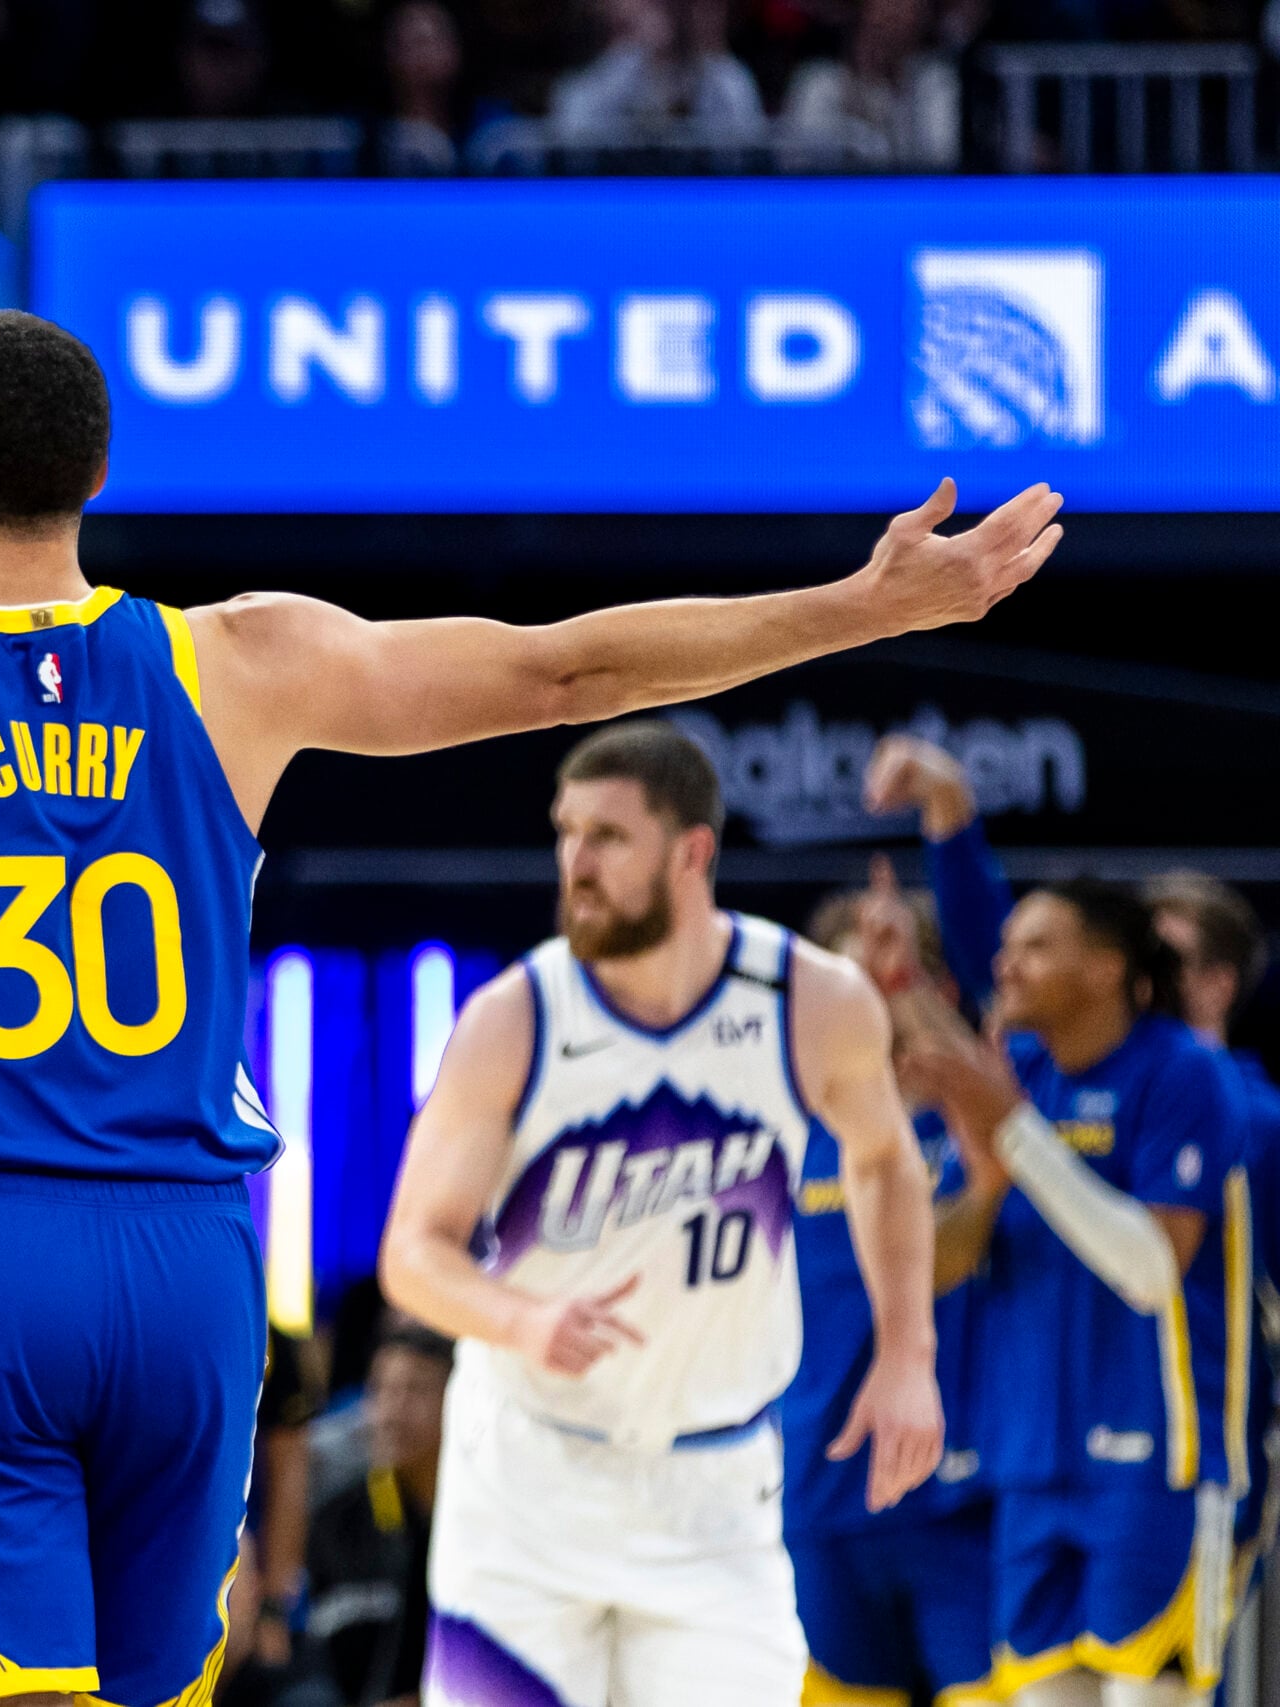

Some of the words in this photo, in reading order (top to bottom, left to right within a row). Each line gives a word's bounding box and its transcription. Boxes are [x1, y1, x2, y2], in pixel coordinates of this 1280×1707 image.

[129, 294, 859, 401] UNITED
[541, 1129, 782, 1254] UTAH
[683, 1208, 754, 1289] 10
